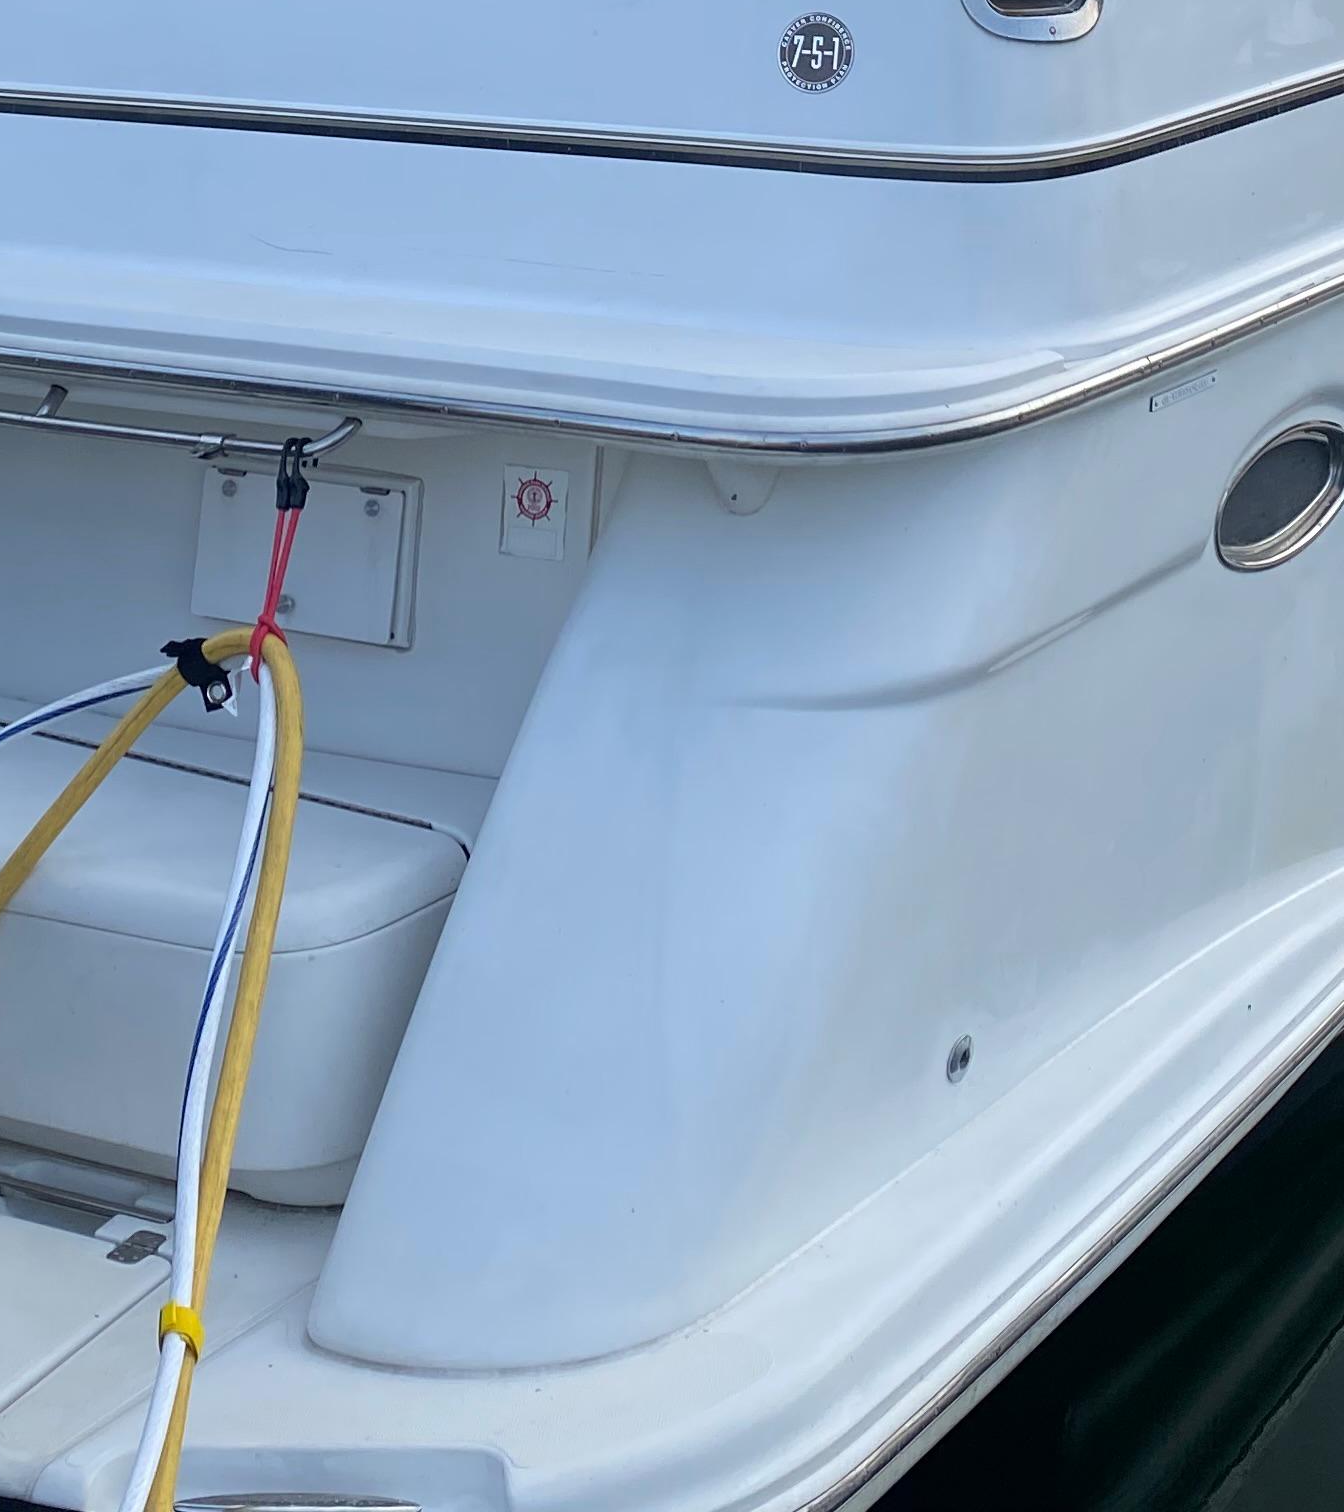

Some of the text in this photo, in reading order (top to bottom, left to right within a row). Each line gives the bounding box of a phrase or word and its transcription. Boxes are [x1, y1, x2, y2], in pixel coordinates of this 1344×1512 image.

[781, 16, 851, 50] CARVER CONFIDENCE
[792, 35, 839, 70] 7-5-1
[782, 61, 848, 90] PROTECTION PLAN
